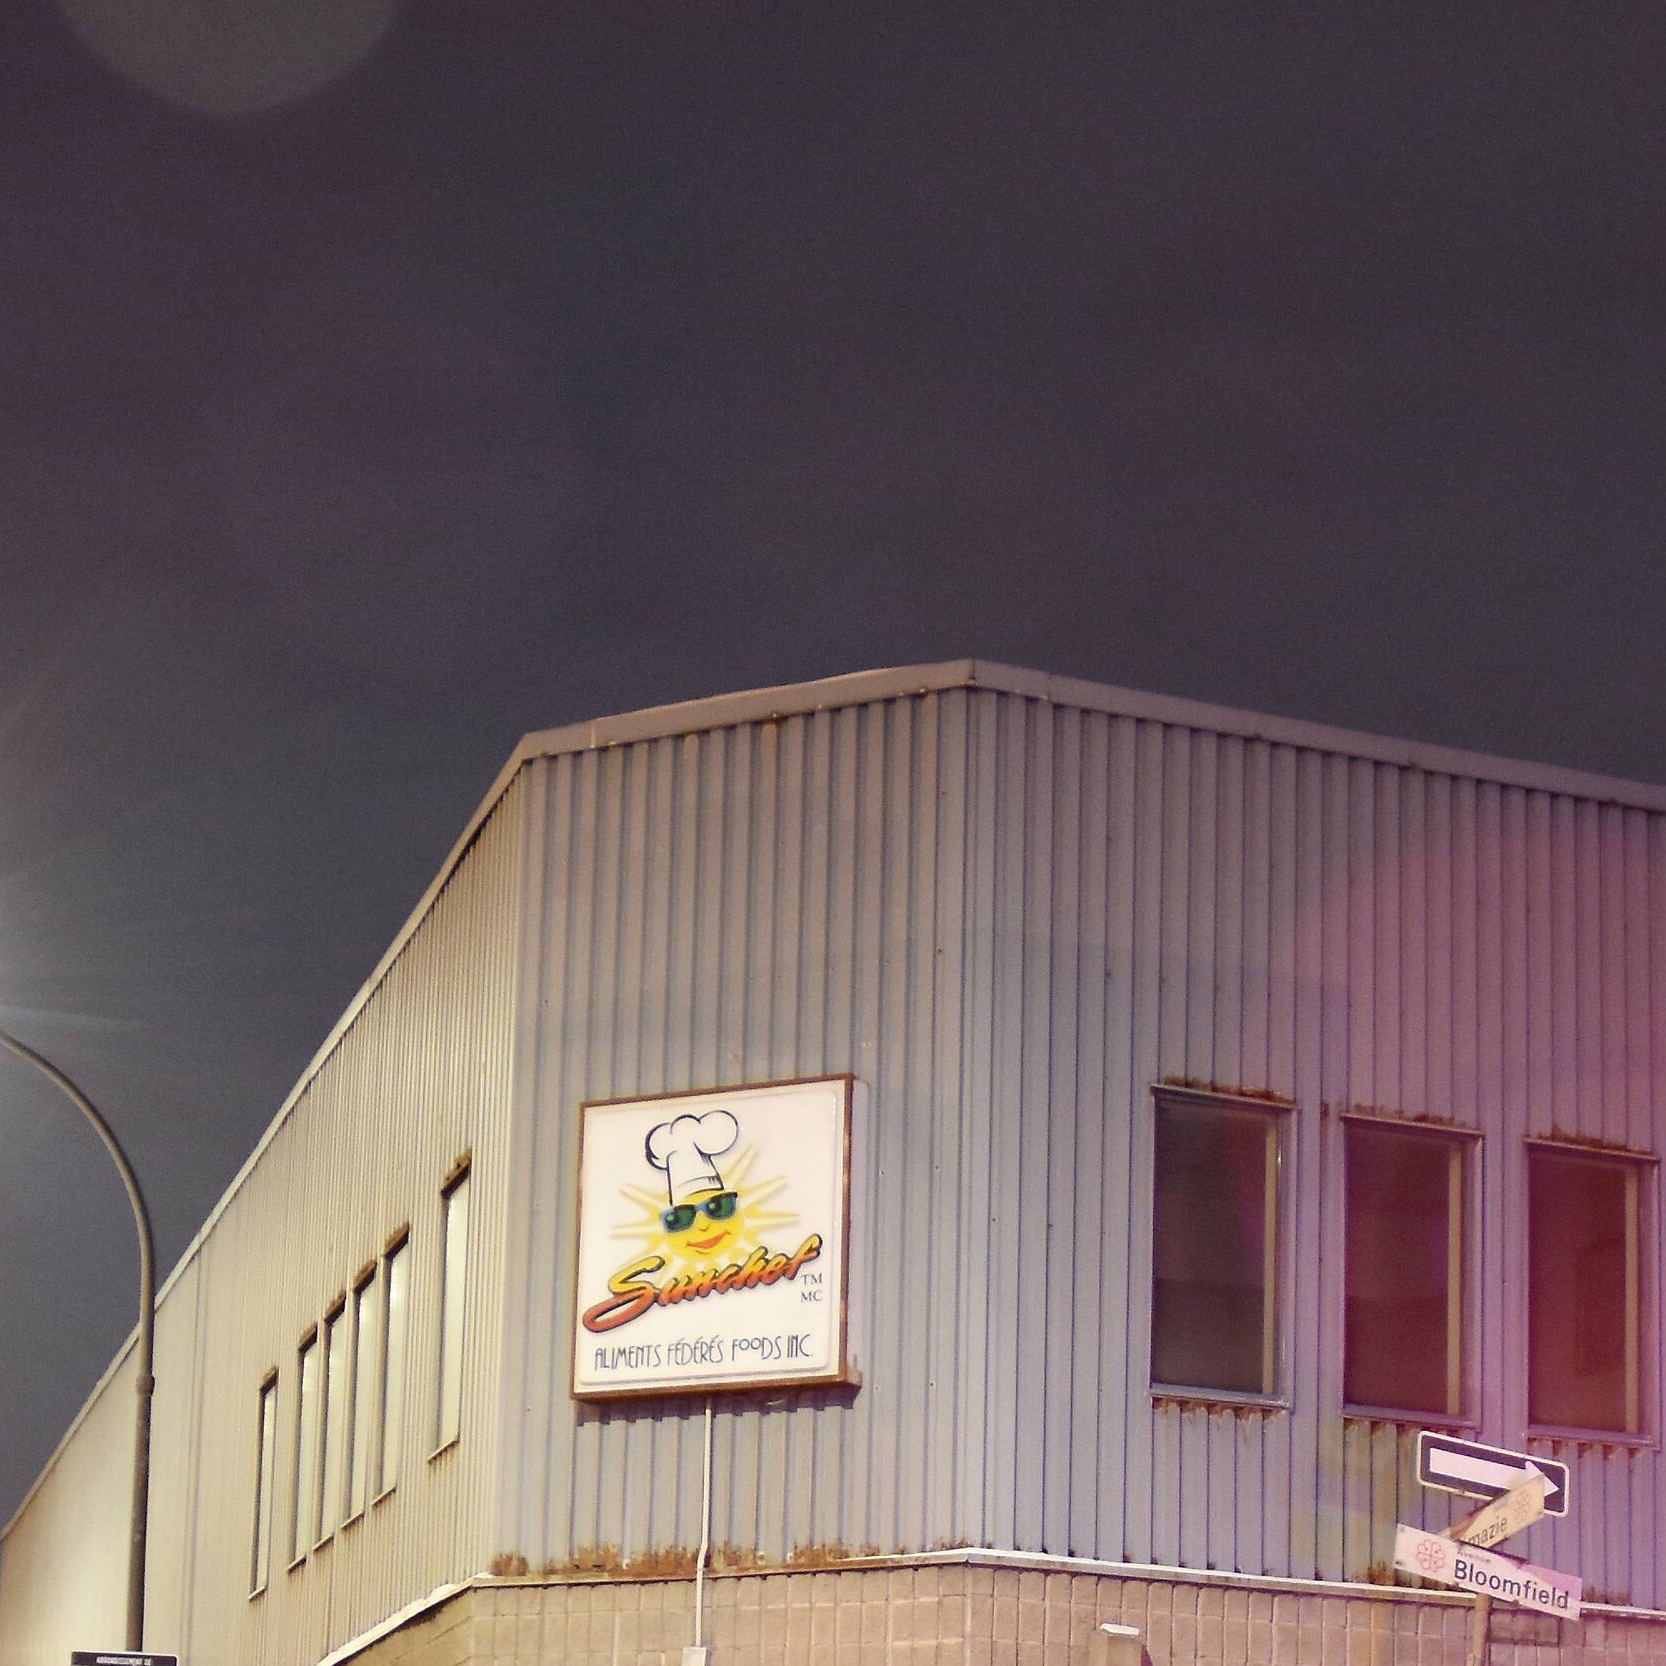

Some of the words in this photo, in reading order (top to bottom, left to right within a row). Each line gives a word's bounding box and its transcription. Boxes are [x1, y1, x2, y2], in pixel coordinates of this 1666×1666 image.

[800, 1273, 823, 1285] TM
[800, 1291, 823, 1303] MC
[594, 1343, 662, 1371] ALIMENTS
[667, 1334, 725, 1367] FÉDÉRÉS
[732, 1334, 782, 1362] FOODS
[1454, 1558, 1570, 1610] Bloomfield
